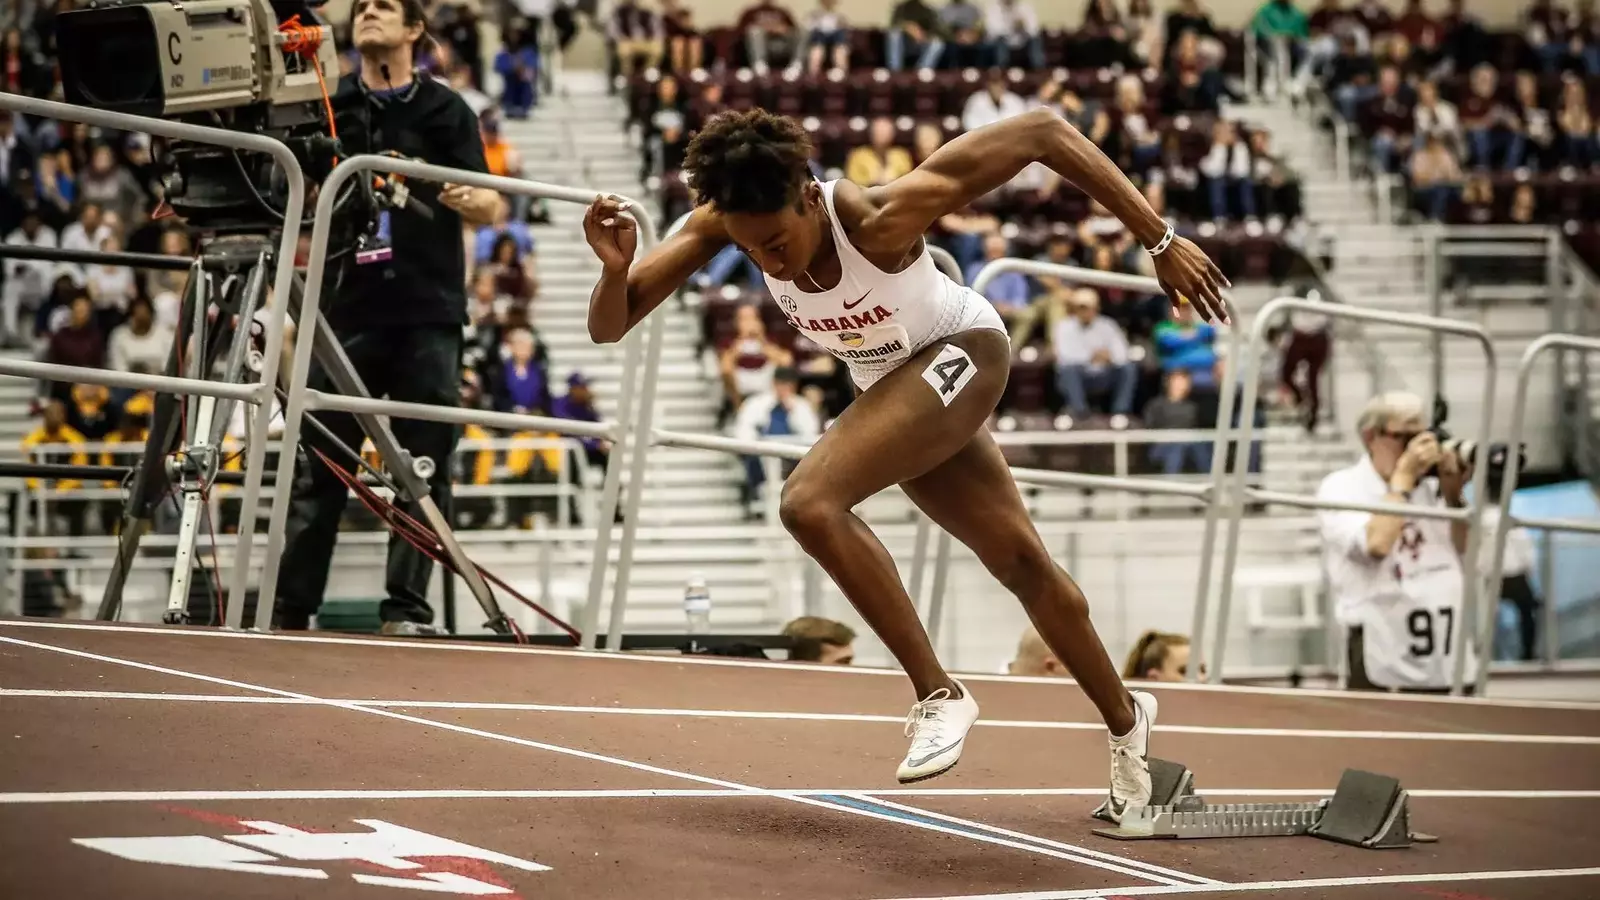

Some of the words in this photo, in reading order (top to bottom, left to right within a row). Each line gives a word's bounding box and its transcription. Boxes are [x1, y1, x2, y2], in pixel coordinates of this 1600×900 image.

[168, 31, 182, 65] C
[788, 305, 892, 331] LABAMA
[932, 356, 969, 396] 4
[1407, 606, 1453, 656] 97
